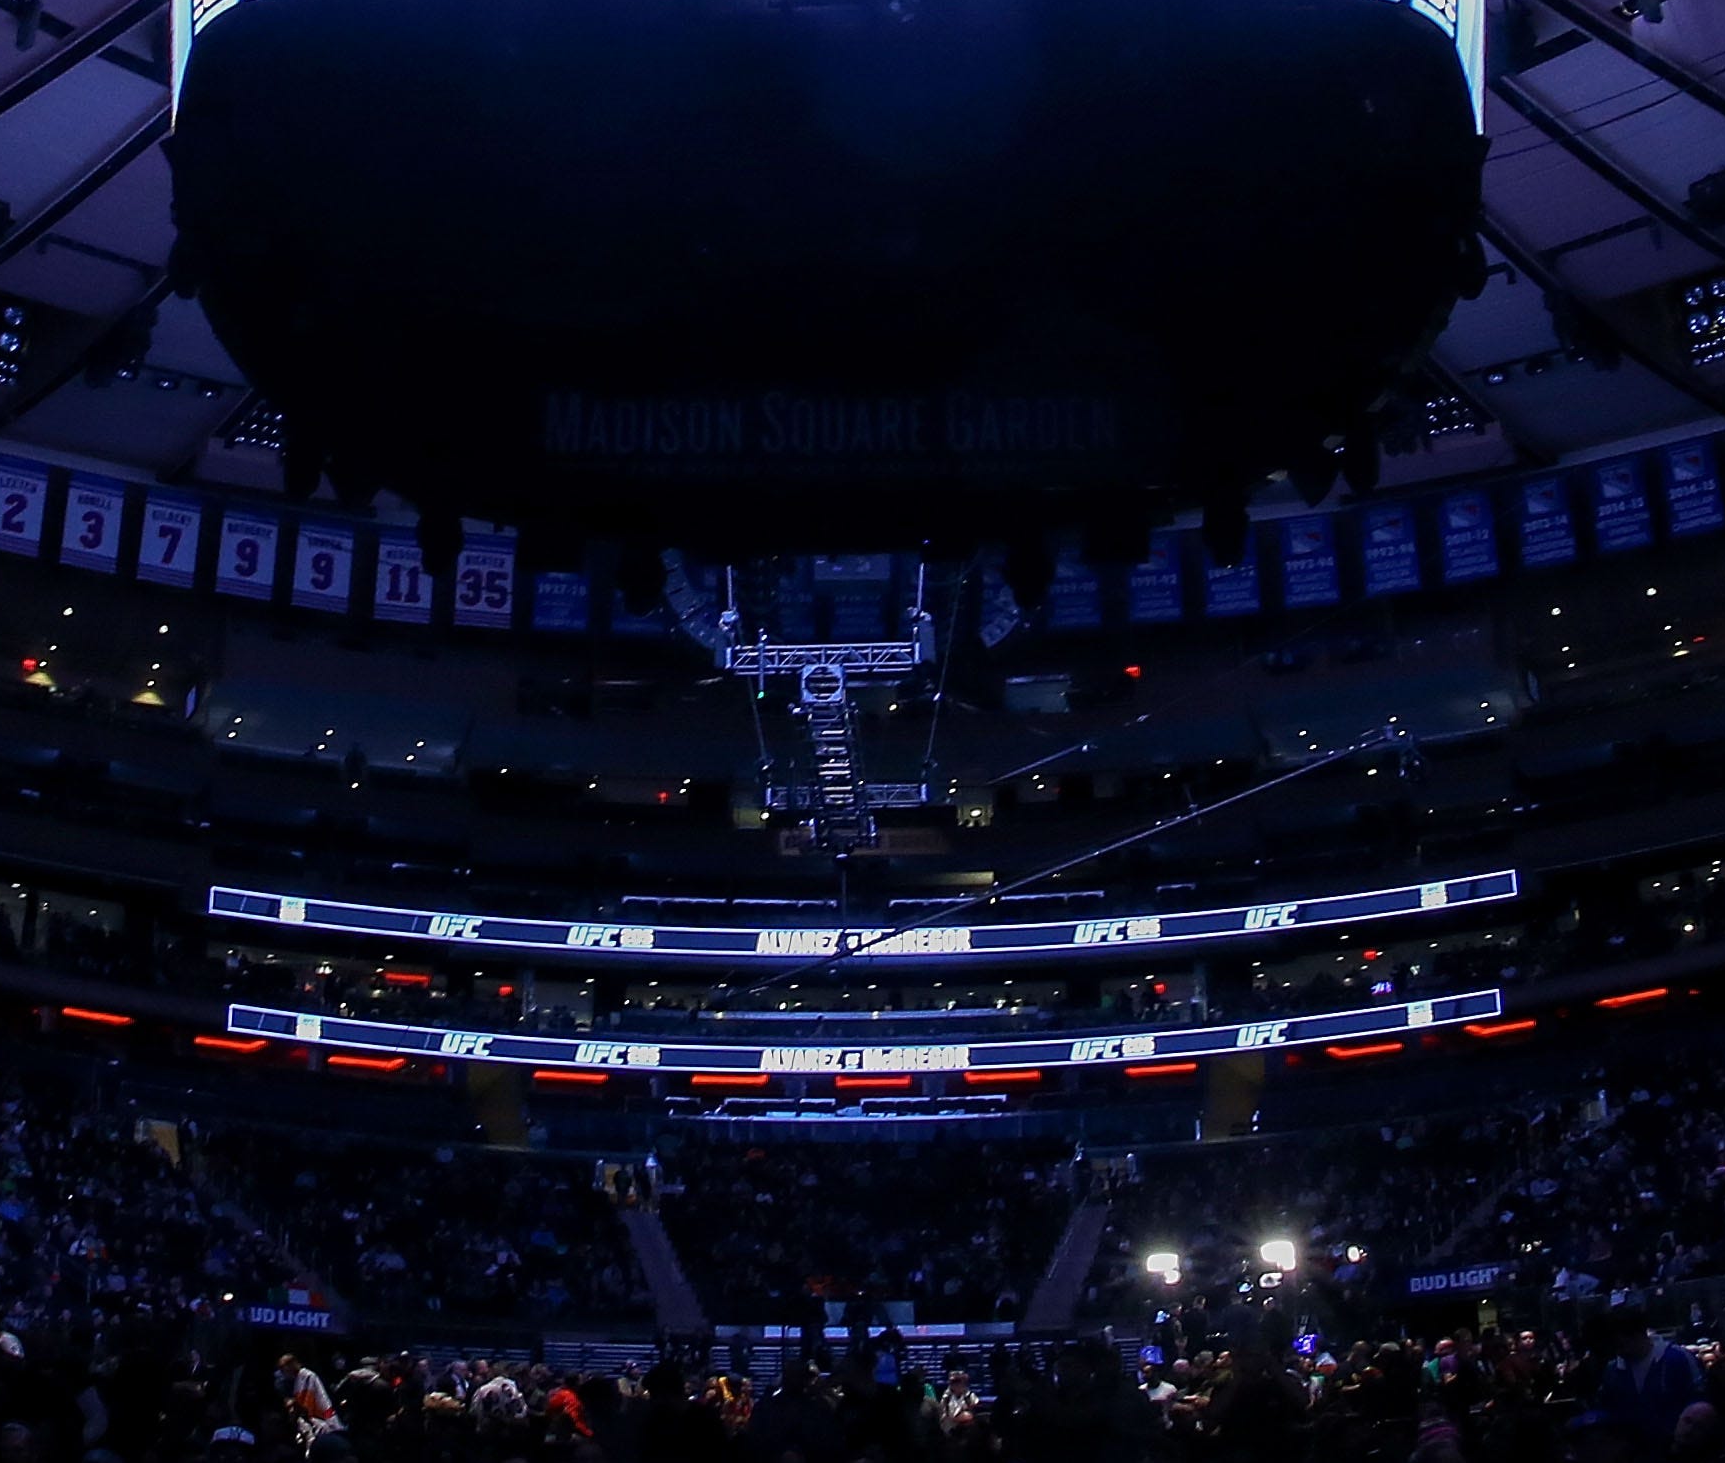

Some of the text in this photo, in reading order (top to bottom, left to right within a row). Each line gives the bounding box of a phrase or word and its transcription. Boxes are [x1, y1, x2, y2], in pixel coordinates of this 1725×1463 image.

[545, 391, 745, 455] MADISON
[760, 388, 929, 455] SQUARE
[2, 494, 28, 533] 2
[80, 511, 104, 549] 3
[158, 524, 183, 564] 7
[234, 539, 260, 576] 9
[311, 553, 335, 590] 9
[386, 565, 420, 603] 11
[460, 569, 510, 609] 35
[428, 915, 483, 939] UFC
[1244, 905, 1298, 929] UFC
[567, 926, 619, 947] UFC
[756, 929, 840, 955] ALVAREZ
[1073, 918, 1161, 943] UFC 205
[440, 1031, 495, 1055] UFC
[1236, 1022, 1288, 1045] UFC
[575, 1043, 627, 1063] UFC
[760, 1046, 843, 1070] ALVAREZ
[862, 1045, 971, 1069] McGREGOR
[1070, 1039, 1121, 1059] UFC
[1410, 1274, 1447, 1292] BUD
[236, 1306, 331, 1328] UD LIGHT
